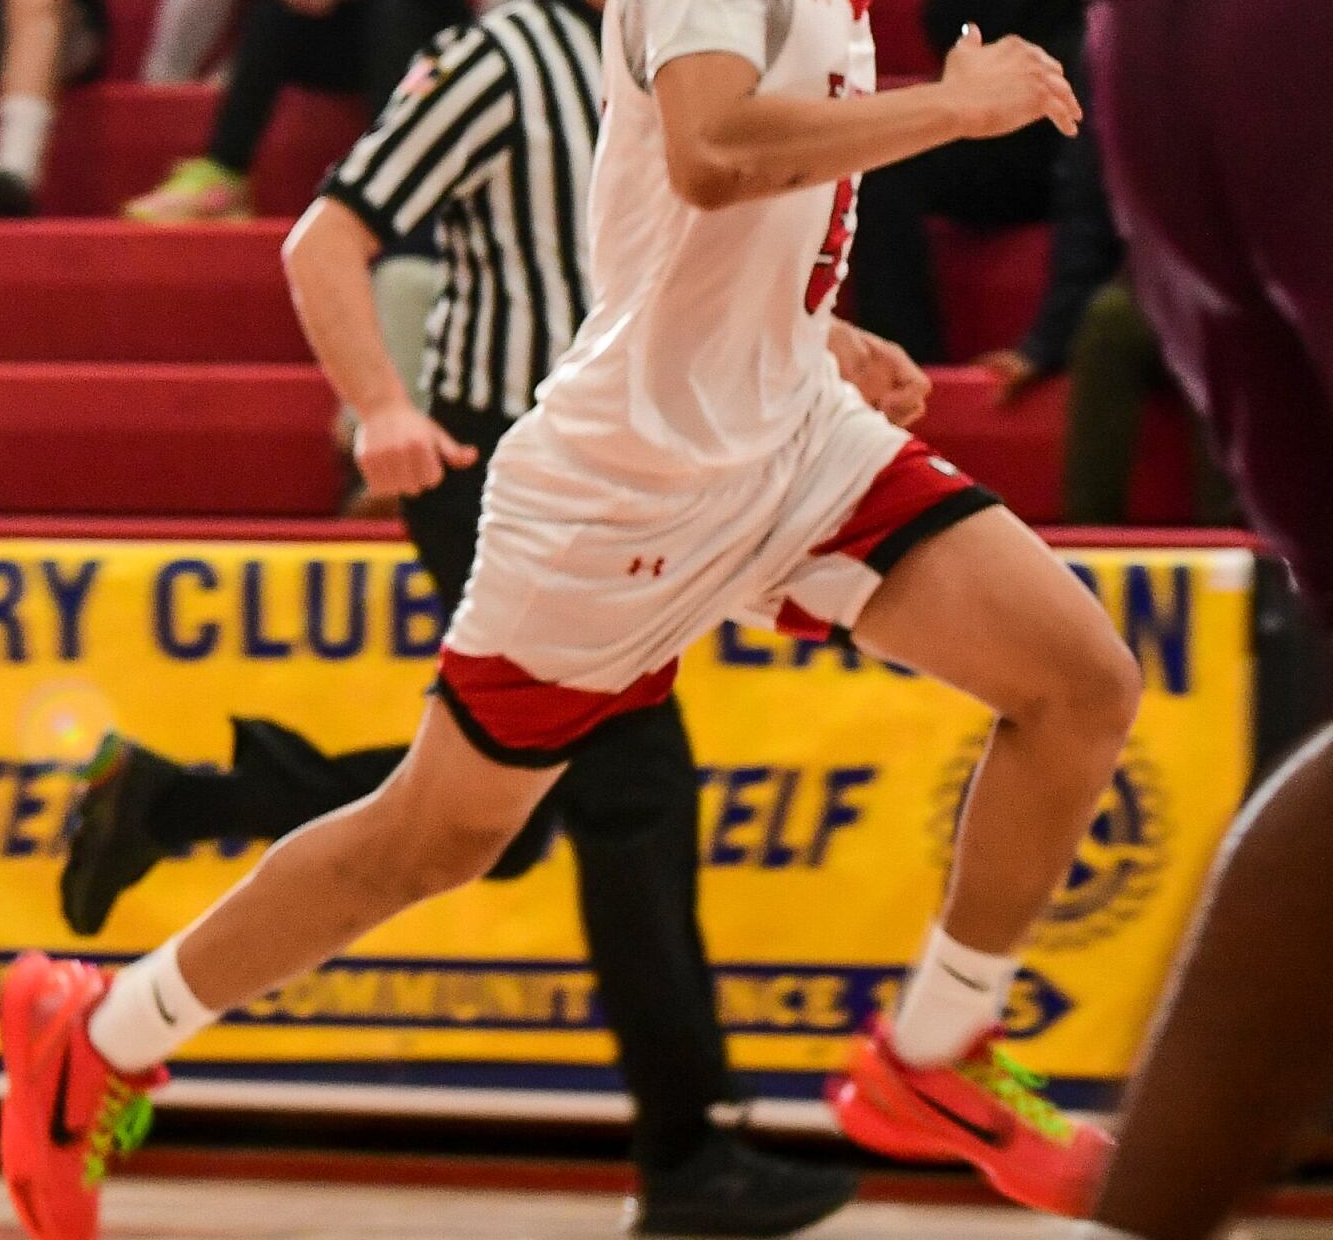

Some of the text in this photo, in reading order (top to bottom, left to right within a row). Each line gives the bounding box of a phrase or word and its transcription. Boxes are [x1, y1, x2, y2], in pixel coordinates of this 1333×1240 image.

[151, 558, 446, 660] CLUB
[695, 763, 879, 870] ELF
[715, 973, 850, 1026] NCE
